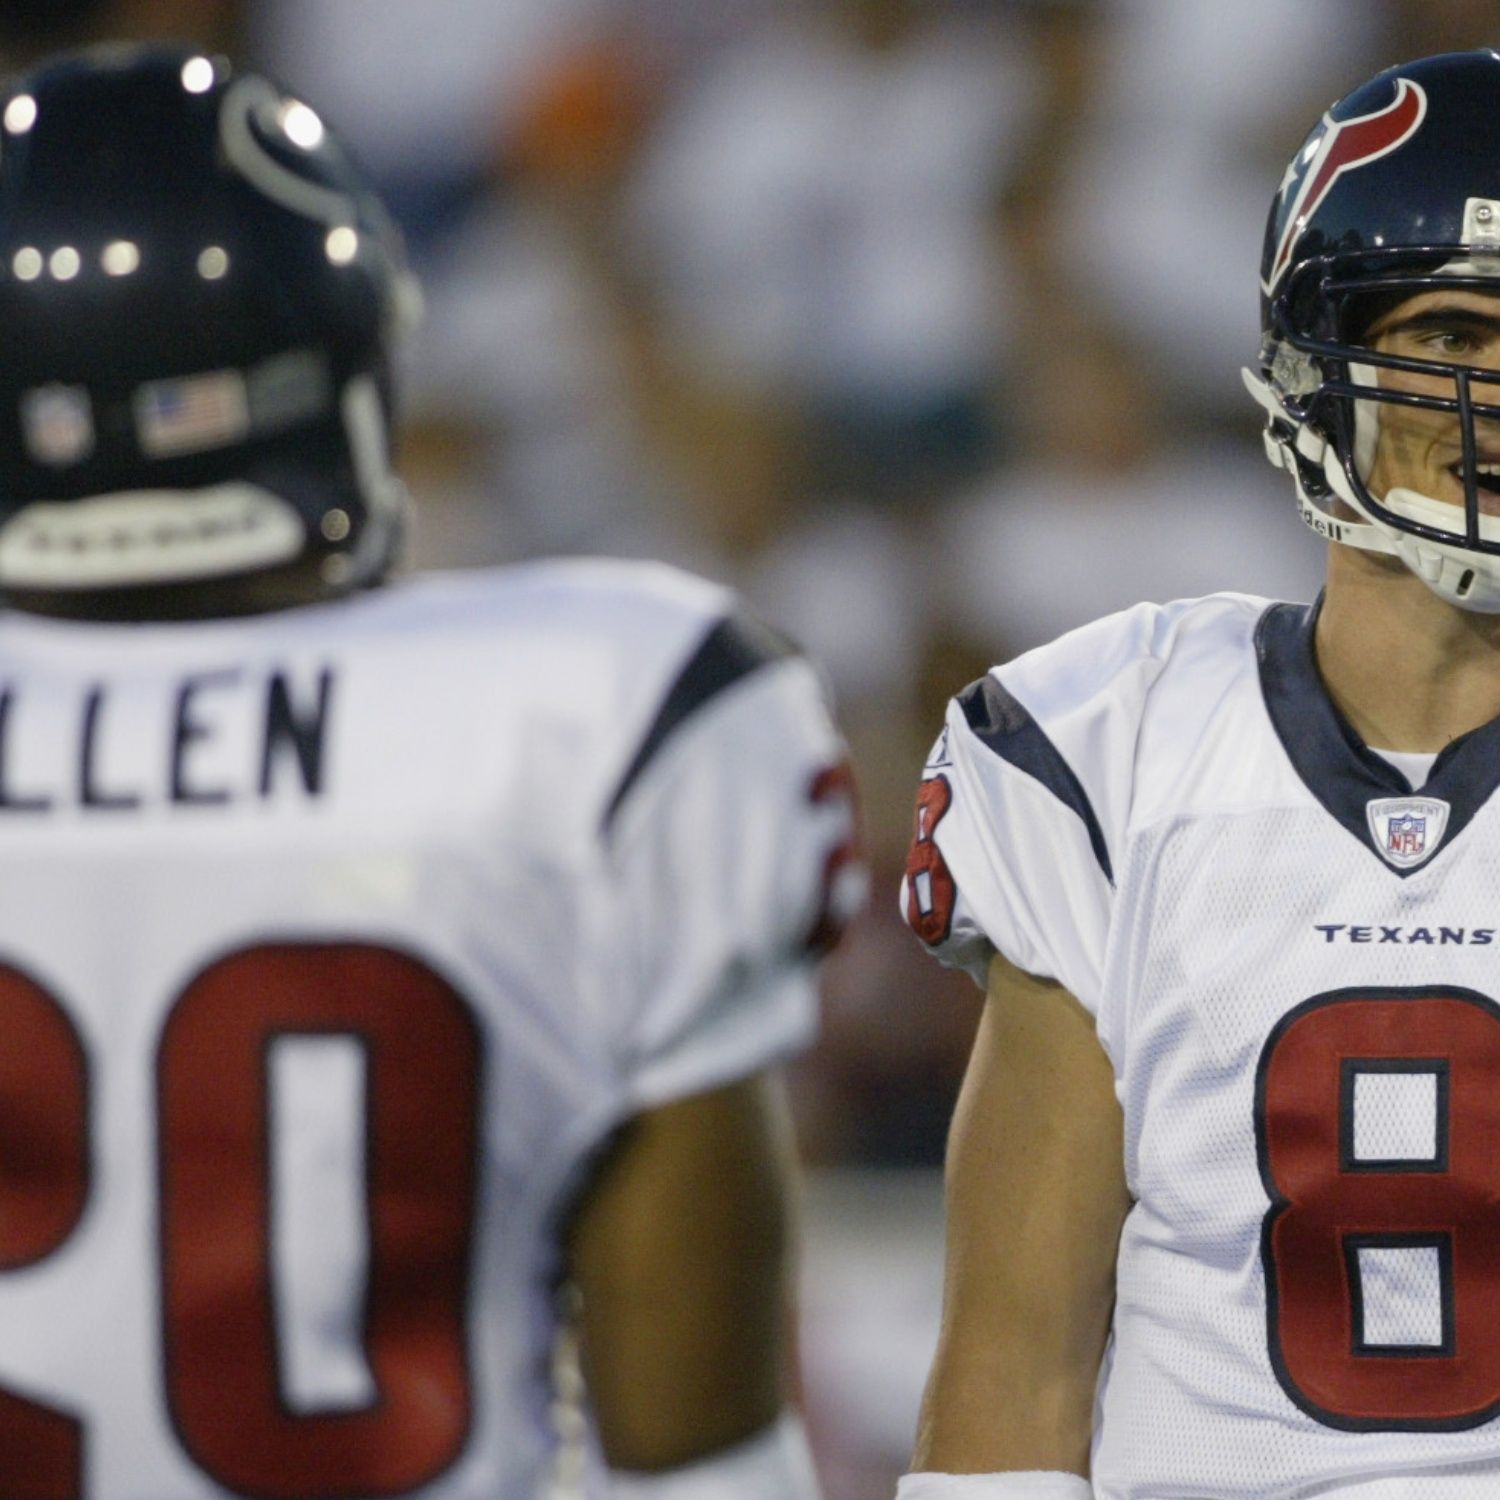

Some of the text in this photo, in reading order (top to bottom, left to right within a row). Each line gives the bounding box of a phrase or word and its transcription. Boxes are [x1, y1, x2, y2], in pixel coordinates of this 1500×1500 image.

[0, 668, 333, 812] LLEN
[904, 773, 958, 947] 8
[1390, 831, 1426, 854] NFL
[1313, 923, 1497, 945] TEXANS
